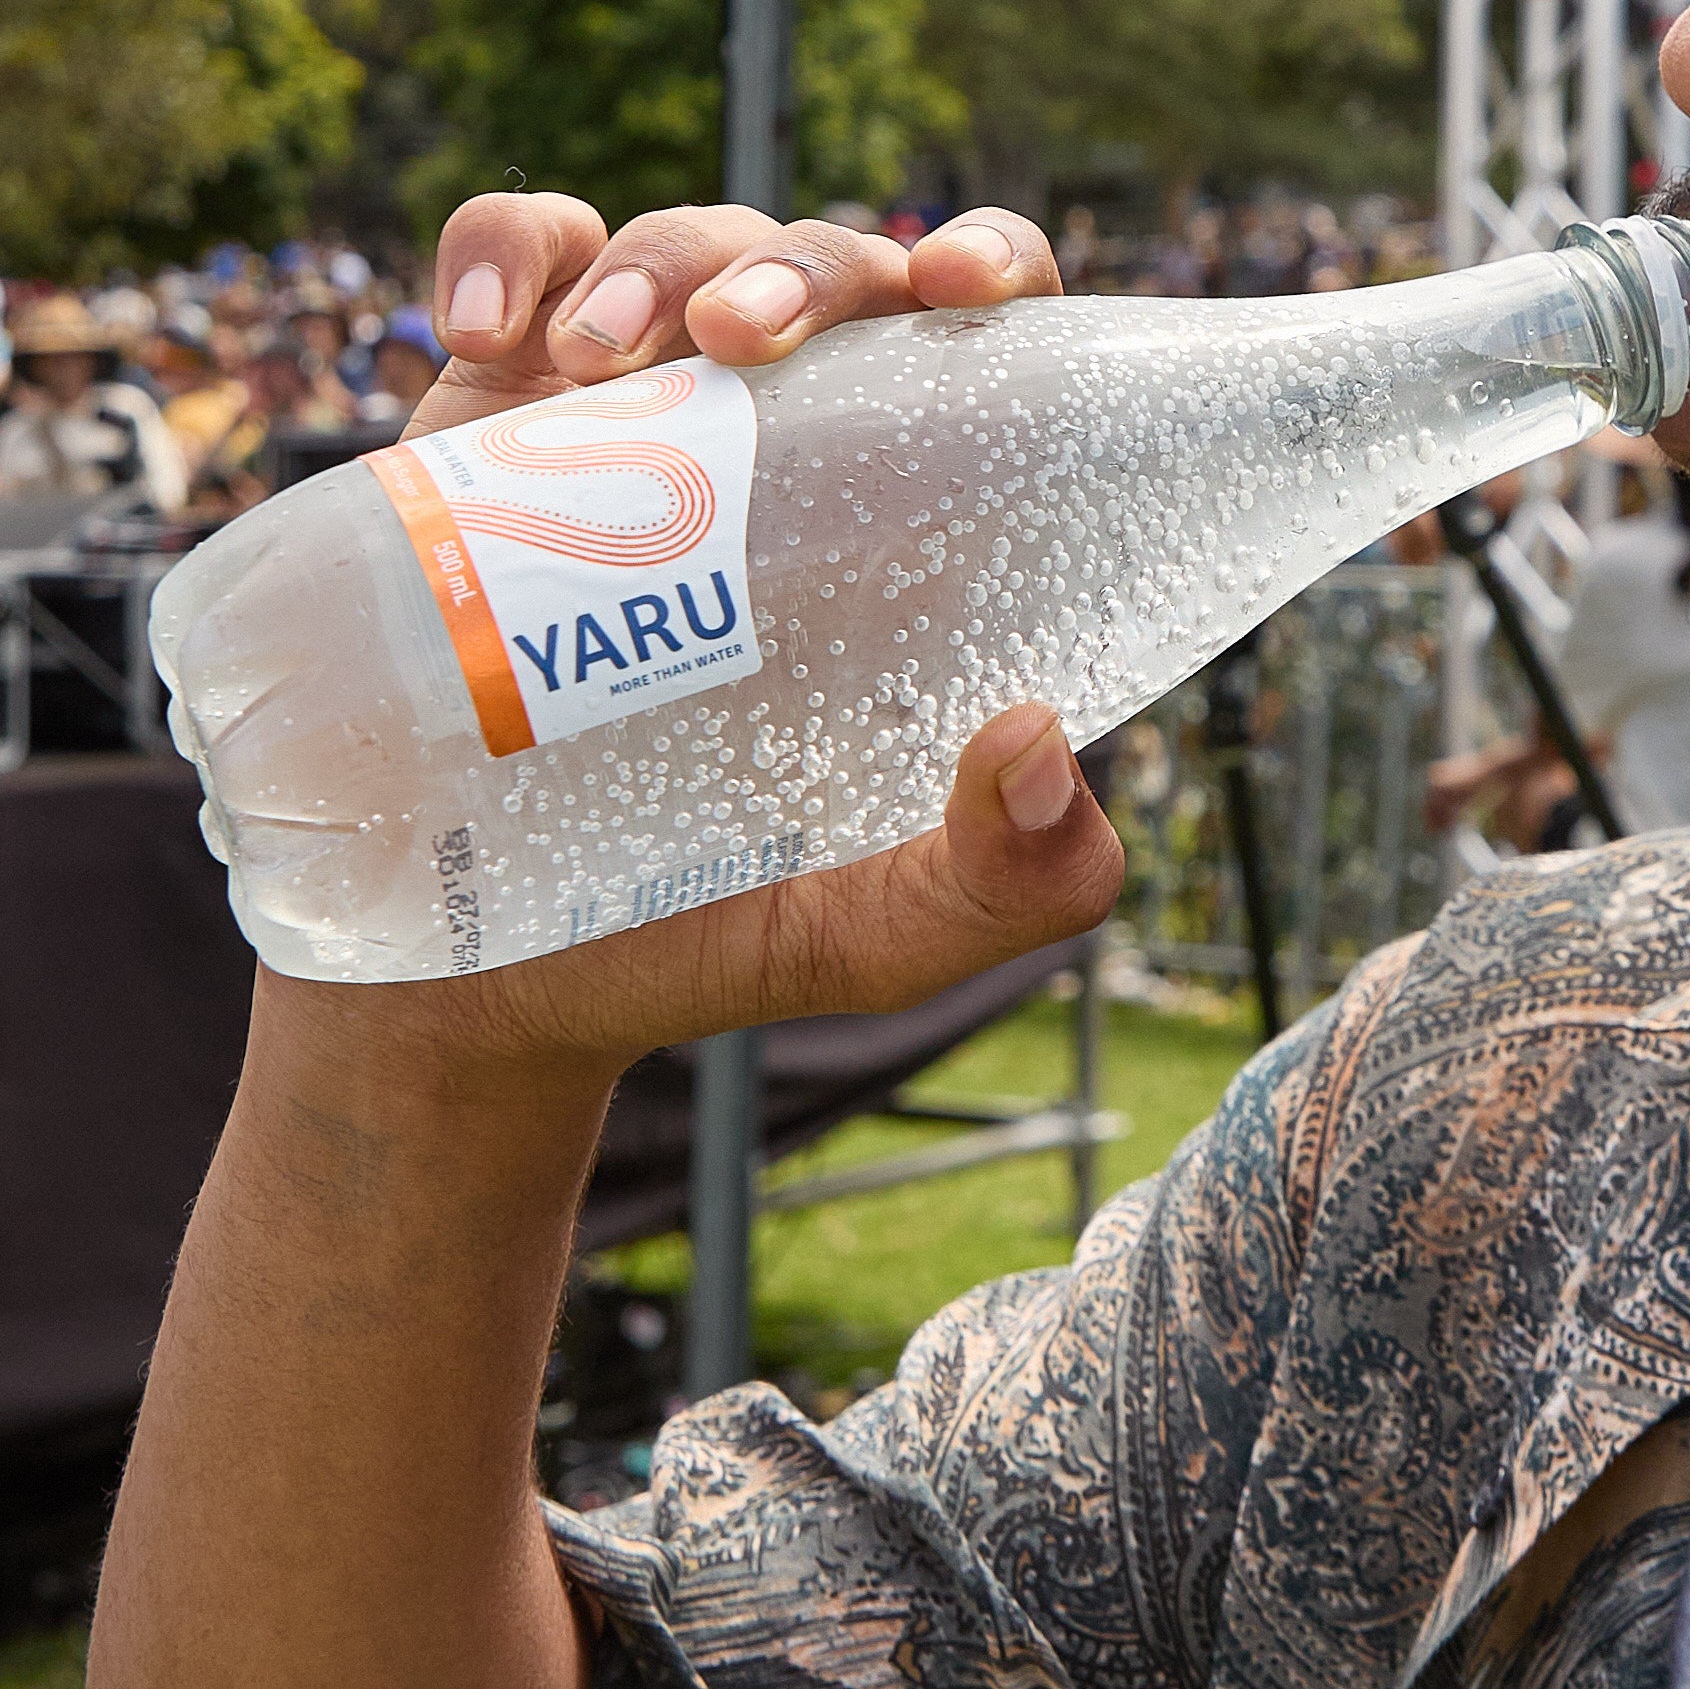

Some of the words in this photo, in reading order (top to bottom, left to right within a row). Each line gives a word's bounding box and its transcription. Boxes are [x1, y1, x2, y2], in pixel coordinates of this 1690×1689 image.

[392, 466, 420, 497] Sugar
[444, 454, 474, 488] WATER
[431, 540, 465, 573] 500
[447, 573, 477, 607] mL
[512, 570, 737, 693] YARU
[609, 674, 651, 696] MORE
[653, 660, 692, 682] THAN
[694, 643, 743, 668] WATER
